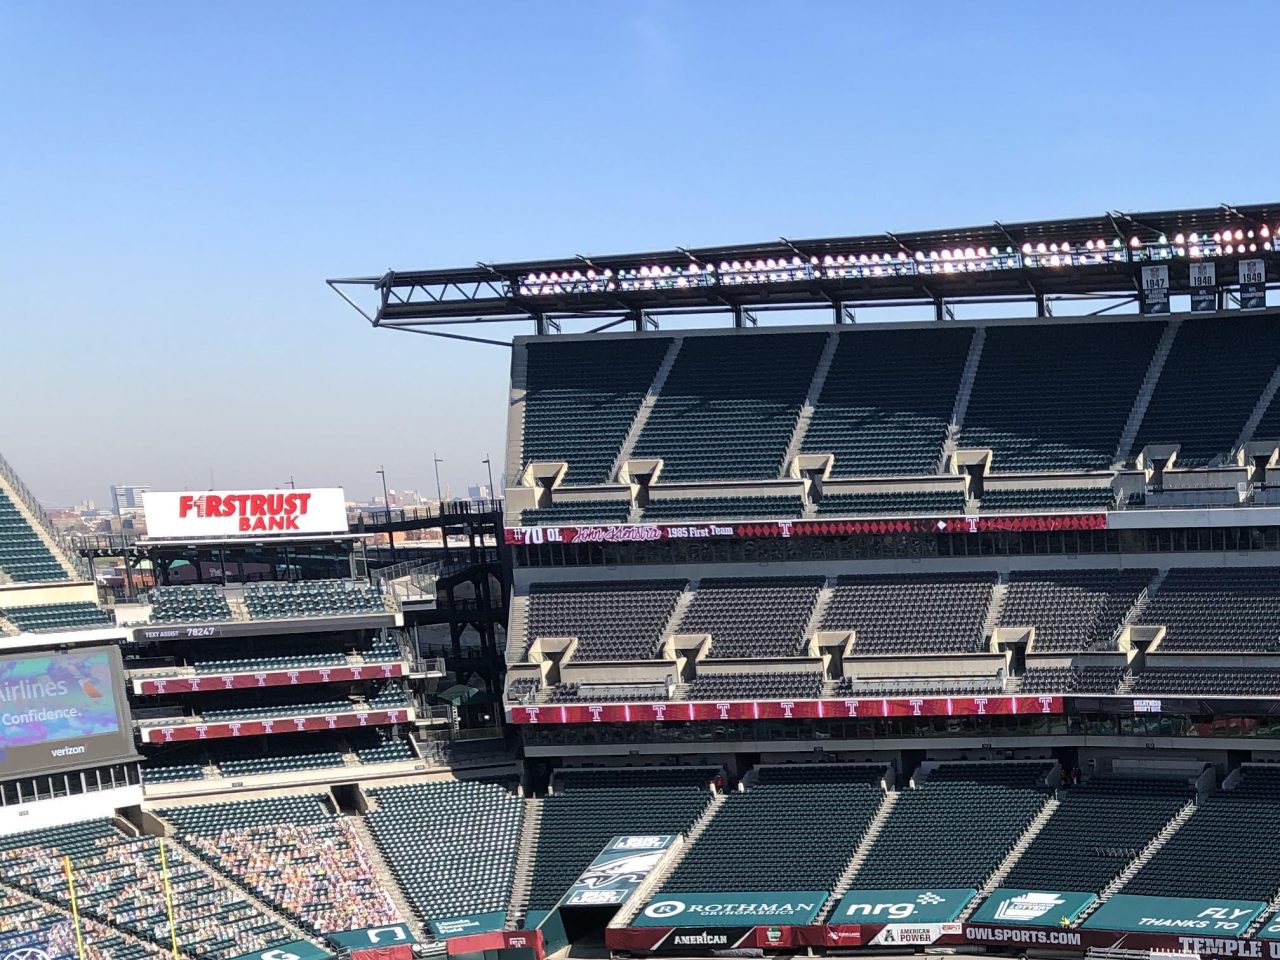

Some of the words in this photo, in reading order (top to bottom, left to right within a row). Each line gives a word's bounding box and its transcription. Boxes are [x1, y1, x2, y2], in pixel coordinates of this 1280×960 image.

[1145, 279, 1164, 288] 1947
[1243, 273, 1262, 282] 1949
[239, 515, 300, 532] BANK
[513, 527, 542, 544] #70
[547, 528, 562, 542] OL
[667, 527, 688, 539] 1985
[689, 527, 709, 538] First
[710, 525, 734, 536] Team
[145, 630, 159, 638] TEXT
[160, 630, 179, 638] ASSIST
[187, 627, 215, 637] 78247
[2, 707, 82, 726] Confidence.
[51, 744, 85, 757] verizon
[683, 903, 815, 912] ROTHMAN
[1196, 907, 1253, 920] FLY
[1139, 918, 1207, 929] THANKS
[1214, 920, 1239, 930] TO
[674, 931, 727, 945] AMERICAN
[966, 927, 1081, 946] OWLSPORTS.COM
[1179, 937, 1263, 958] TEMPLE
